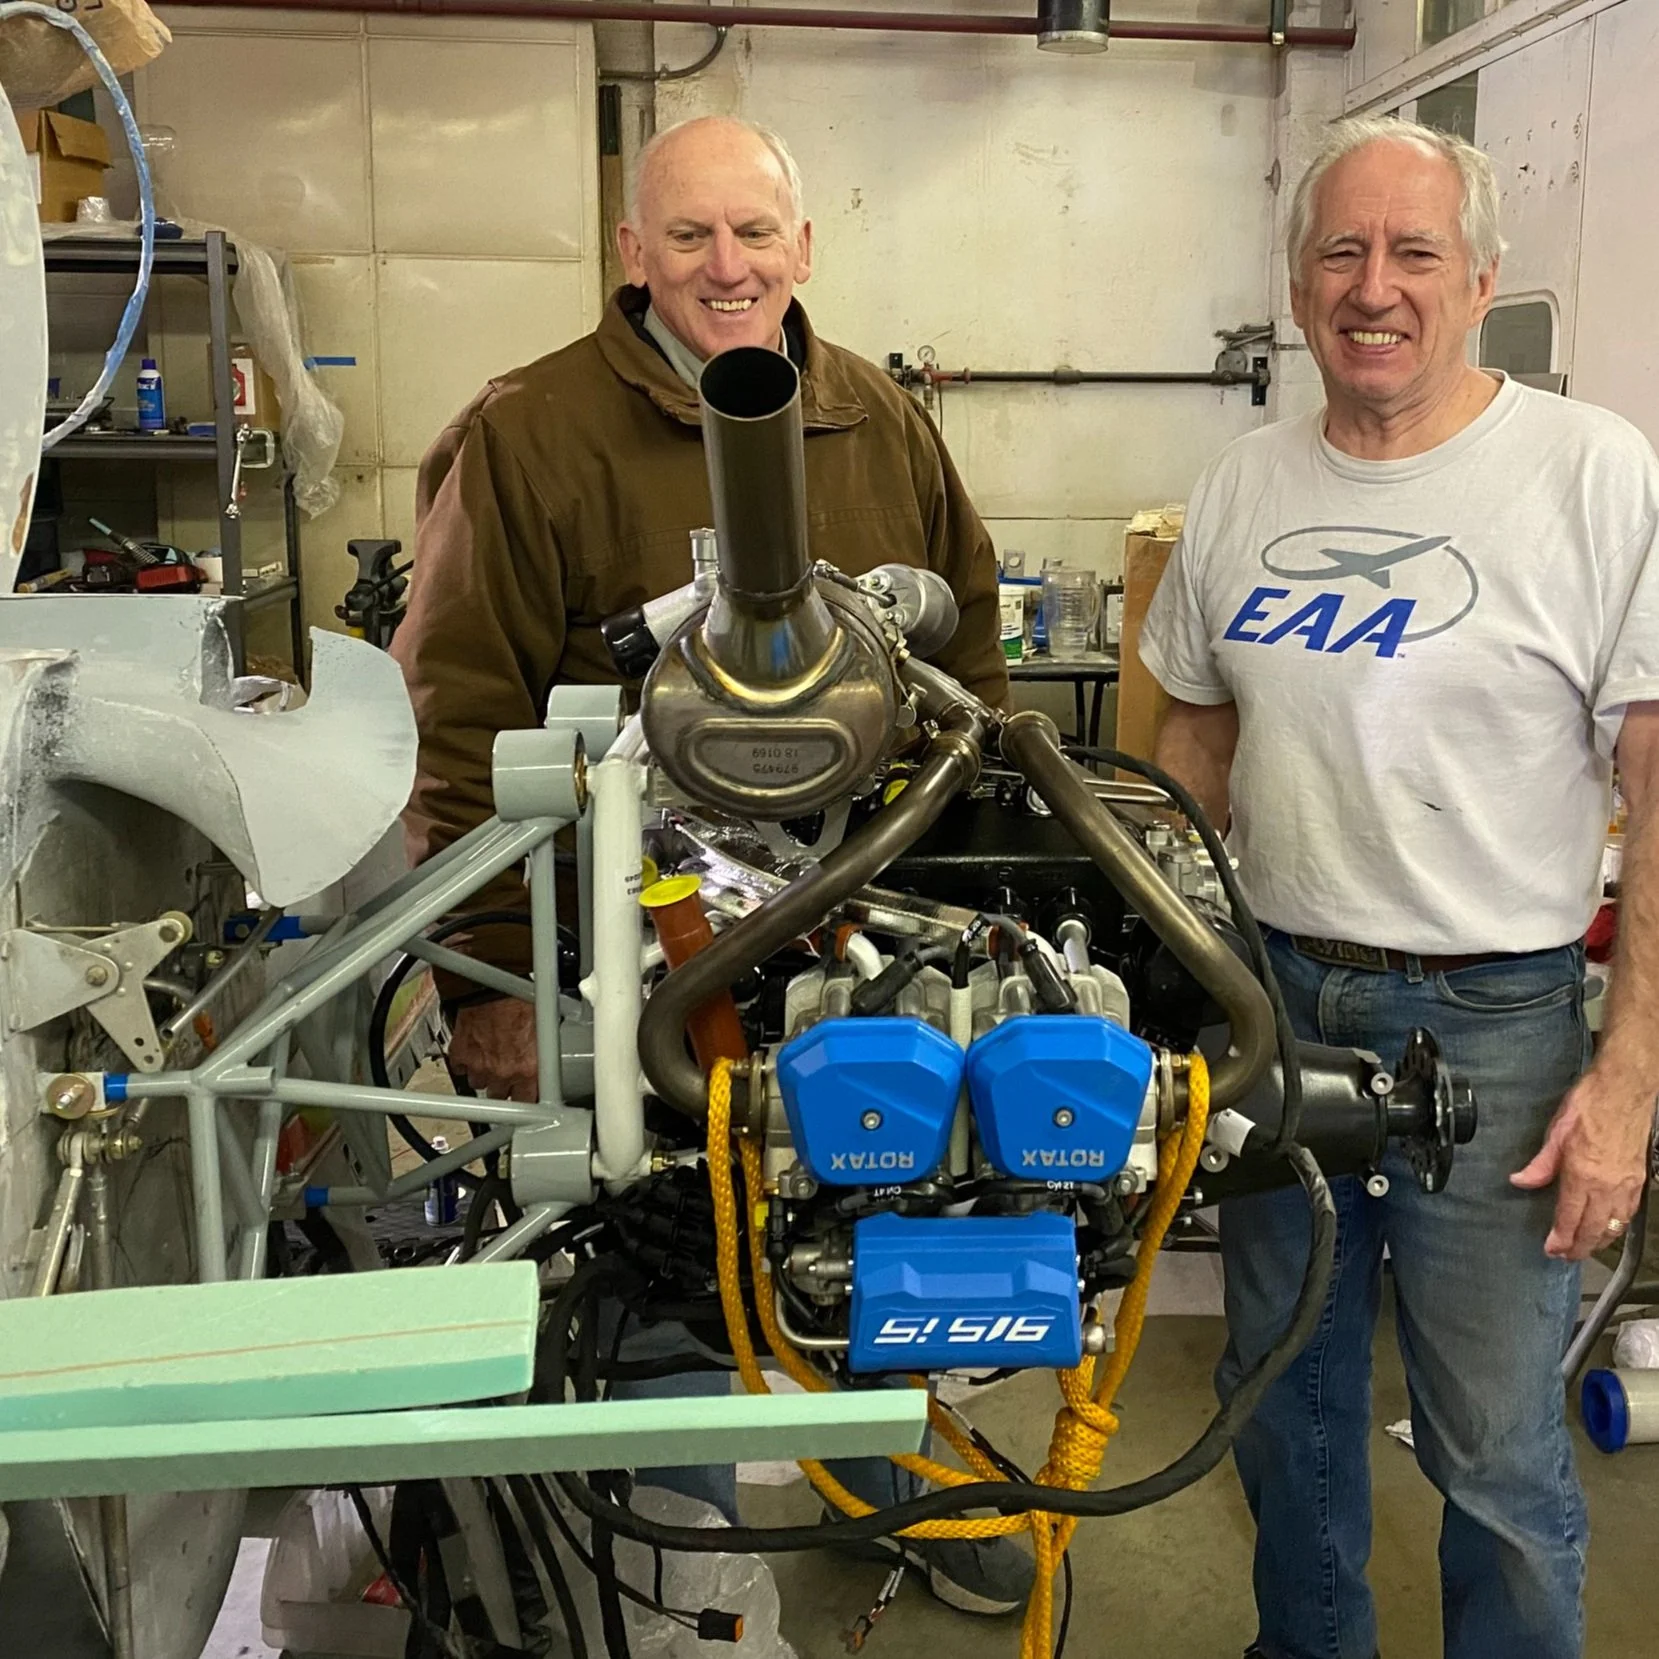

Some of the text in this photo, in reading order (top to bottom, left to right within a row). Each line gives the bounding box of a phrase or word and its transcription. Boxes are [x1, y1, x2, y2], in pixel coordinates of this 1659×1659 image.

[1223, 587, 1417, 658] EAA
[831, 1151, 914, 1170] ROTAX
[1022, 1149, 1104, 1167] ROTAX
[948, 1316, 1056, 1343] 915
